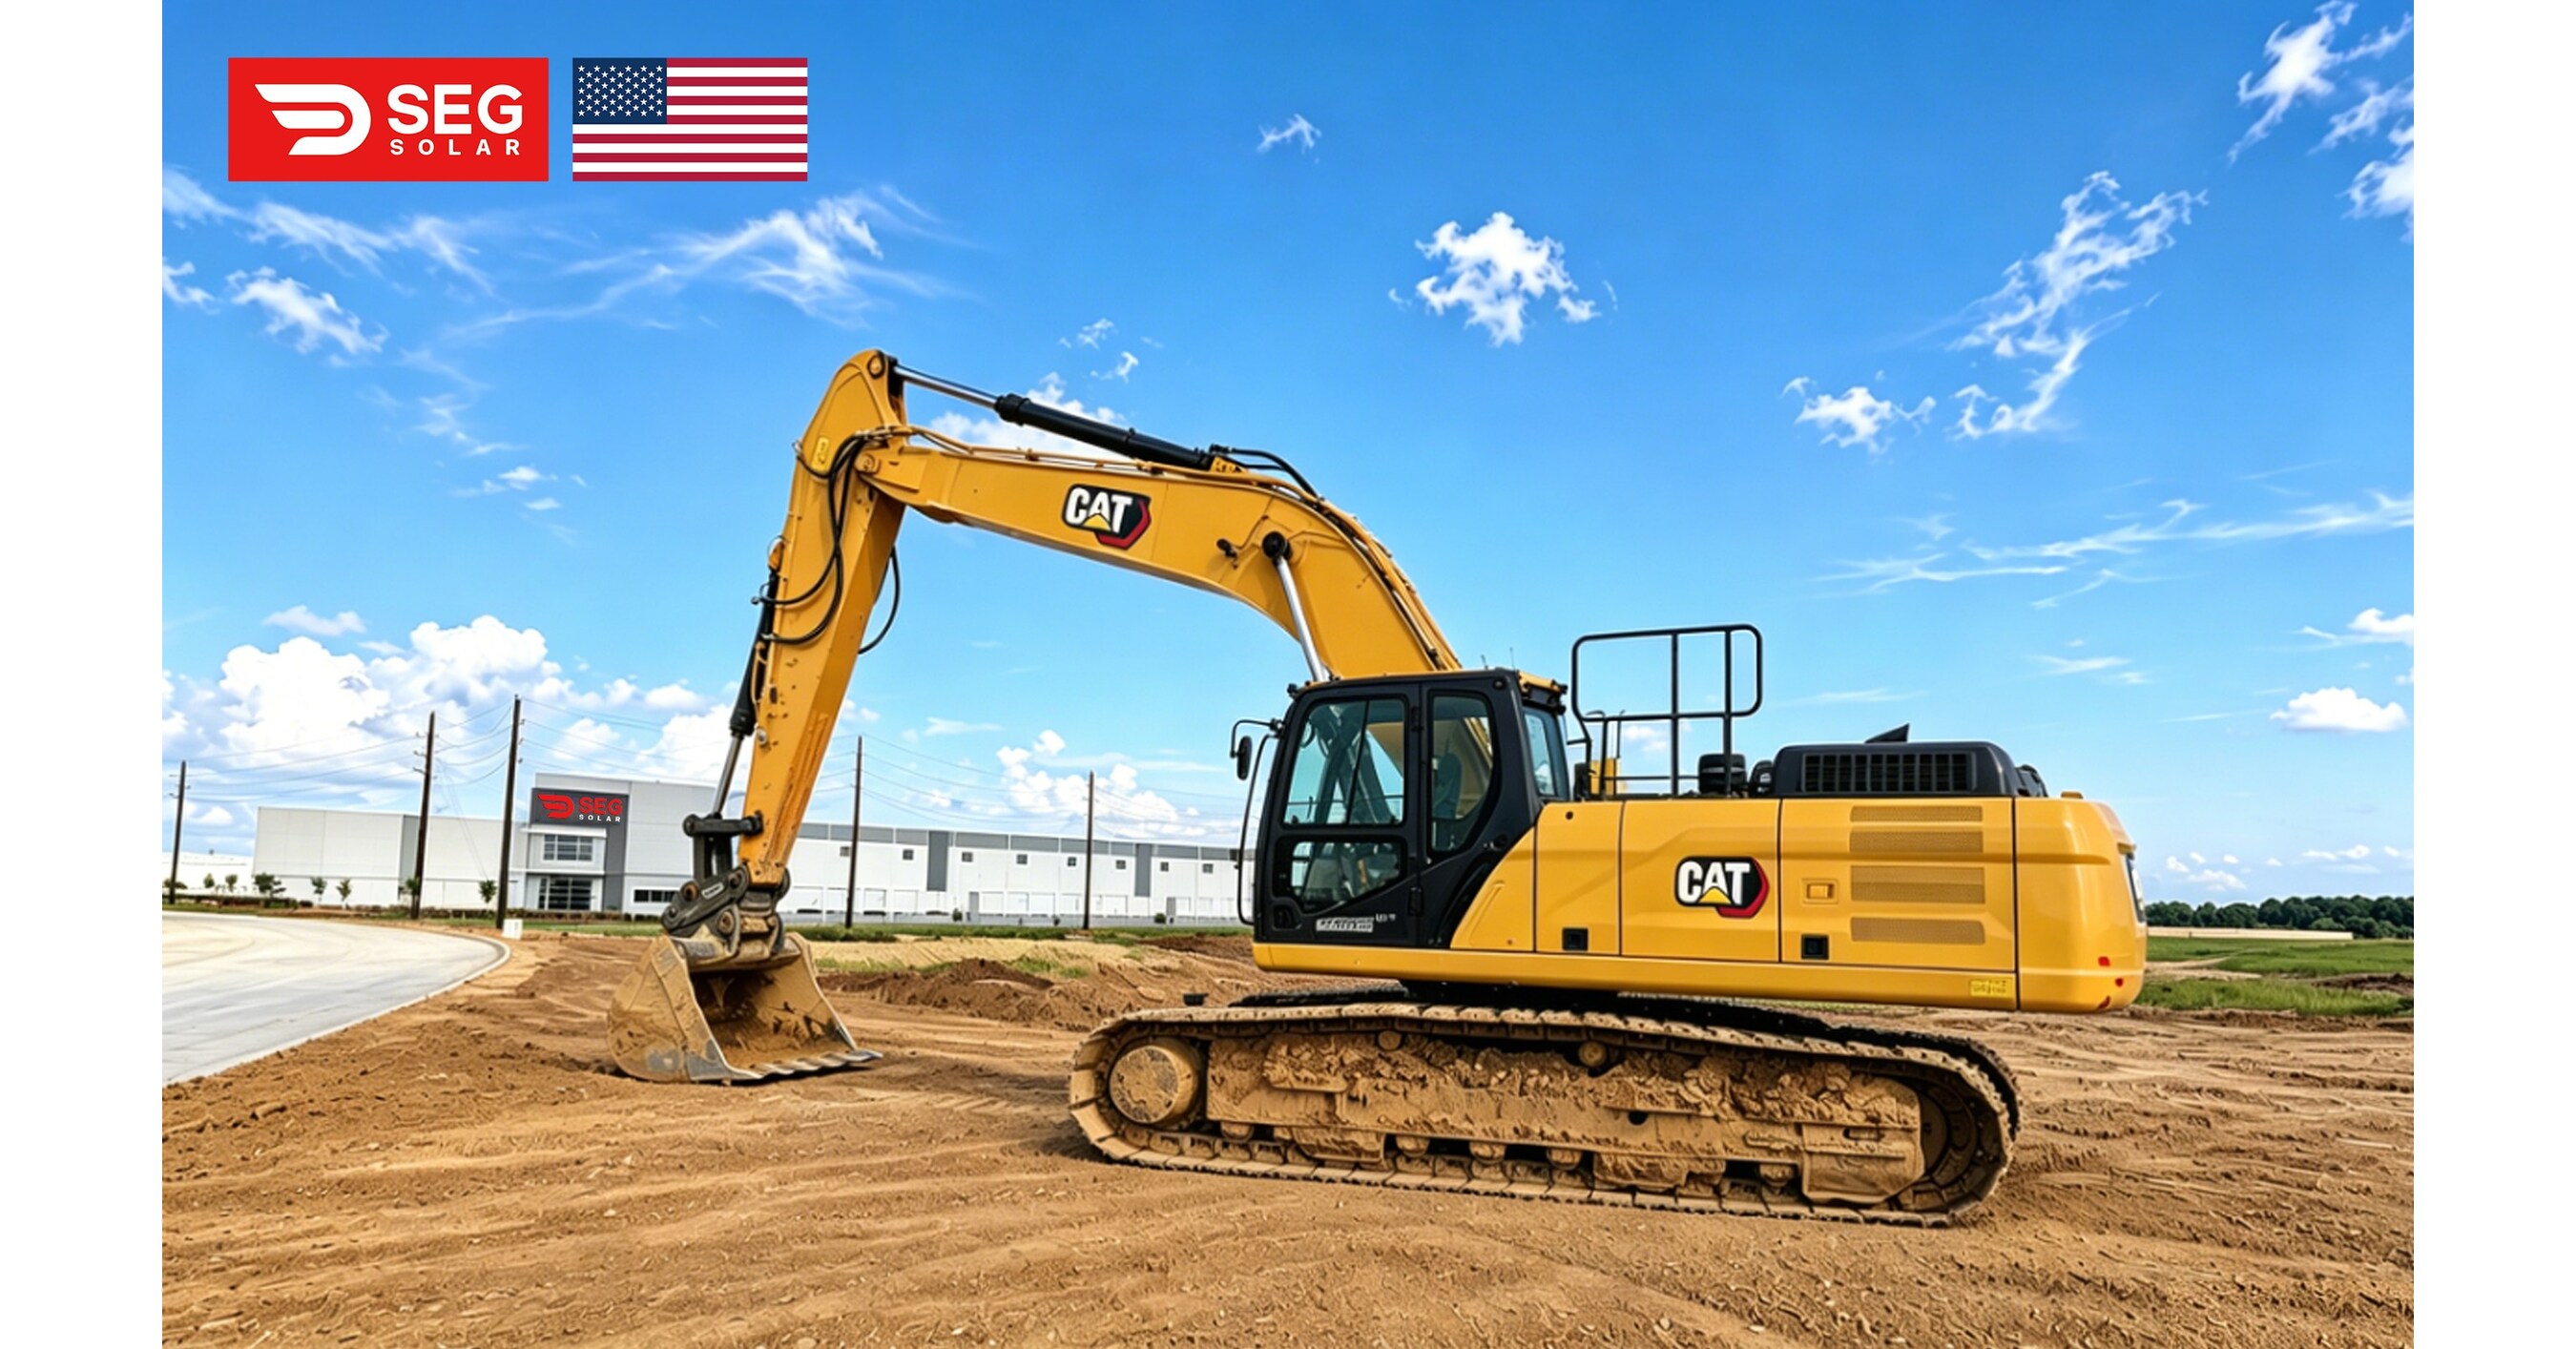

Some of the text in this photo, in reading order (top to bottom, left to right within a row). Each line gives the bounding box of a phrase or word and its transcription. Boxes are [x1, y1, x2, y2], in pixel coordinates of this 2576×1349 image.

[1065, 487, 1133, 534] CAT
[578, 814, 621, 822] SOLAR
[579, 797, 623, 816] SEG
[1677, 861, 1751, 905] CAT
